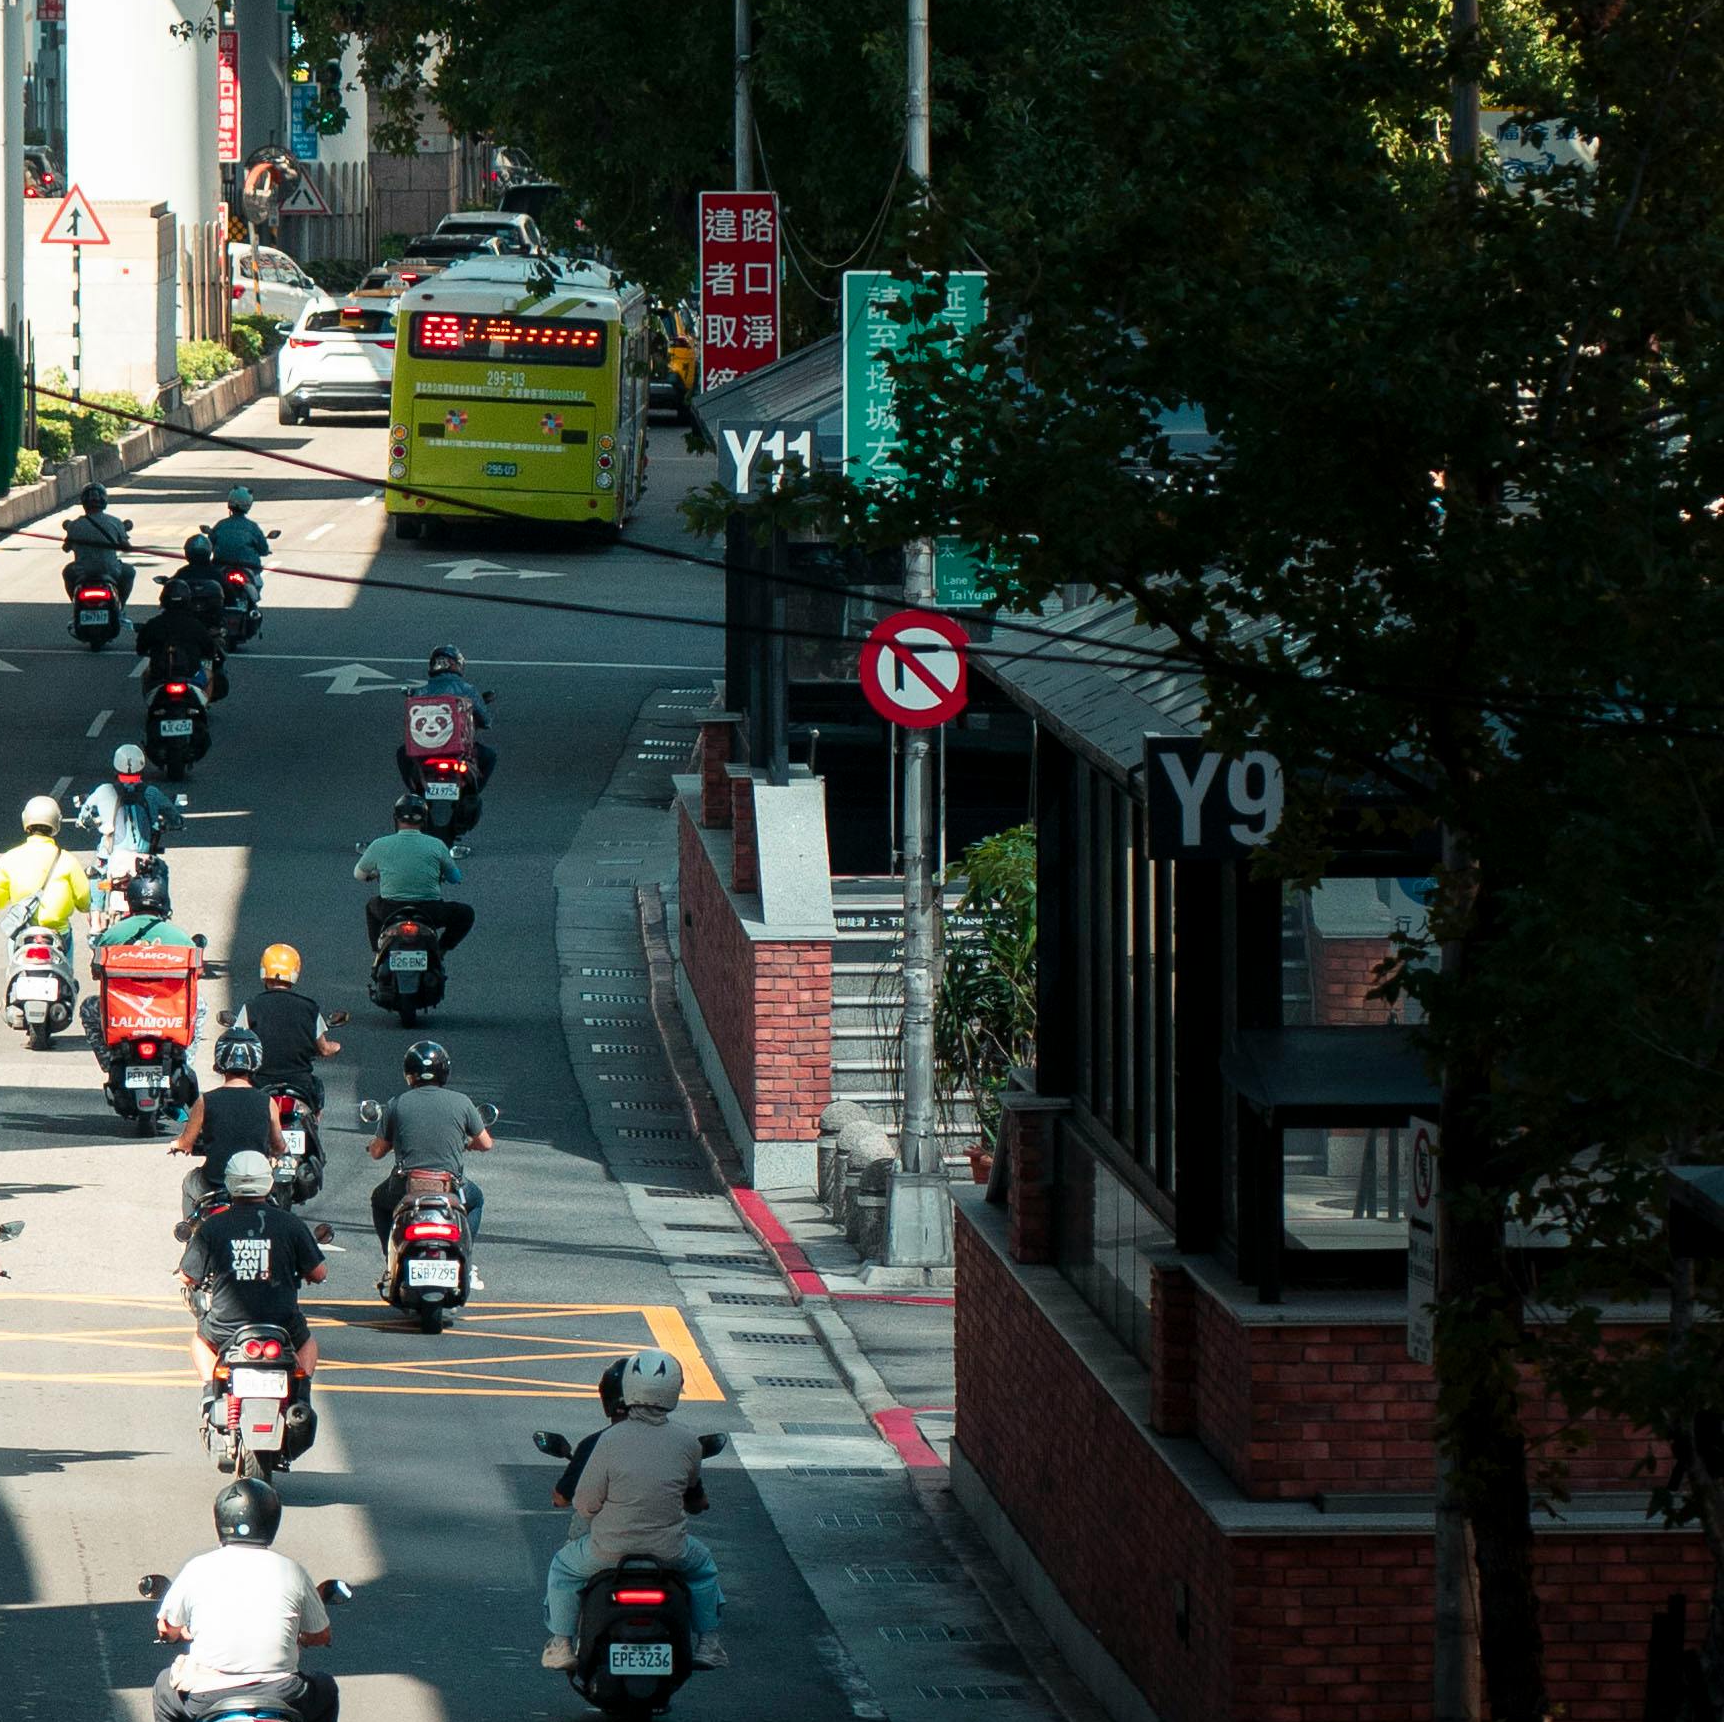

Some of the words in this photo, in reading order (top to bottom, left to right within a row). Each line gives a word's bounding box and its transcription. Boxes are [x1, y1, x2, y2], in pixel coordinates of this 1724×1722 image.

[742, 208, 775, 350] 路口淨
[486, 371, 526, 387] 295-U3
[722, 429, 812, 494] Y11
[943, 575, 968, 585] Lane
[949, 589, 997, 601] TaiYuan
[1162, 751, 1284, 847] Y9
[111, 952, 185, 963] LALAMOVE
[111, 1016, 183, 1029] LALAMOVE
[231, 1239, 271, 1250] WHEN
[232, 1249, 260, 1260] YOU
[232, 1260, 259, 1270] CAN
[612, 1651, 671, 1668] EPE-3236
